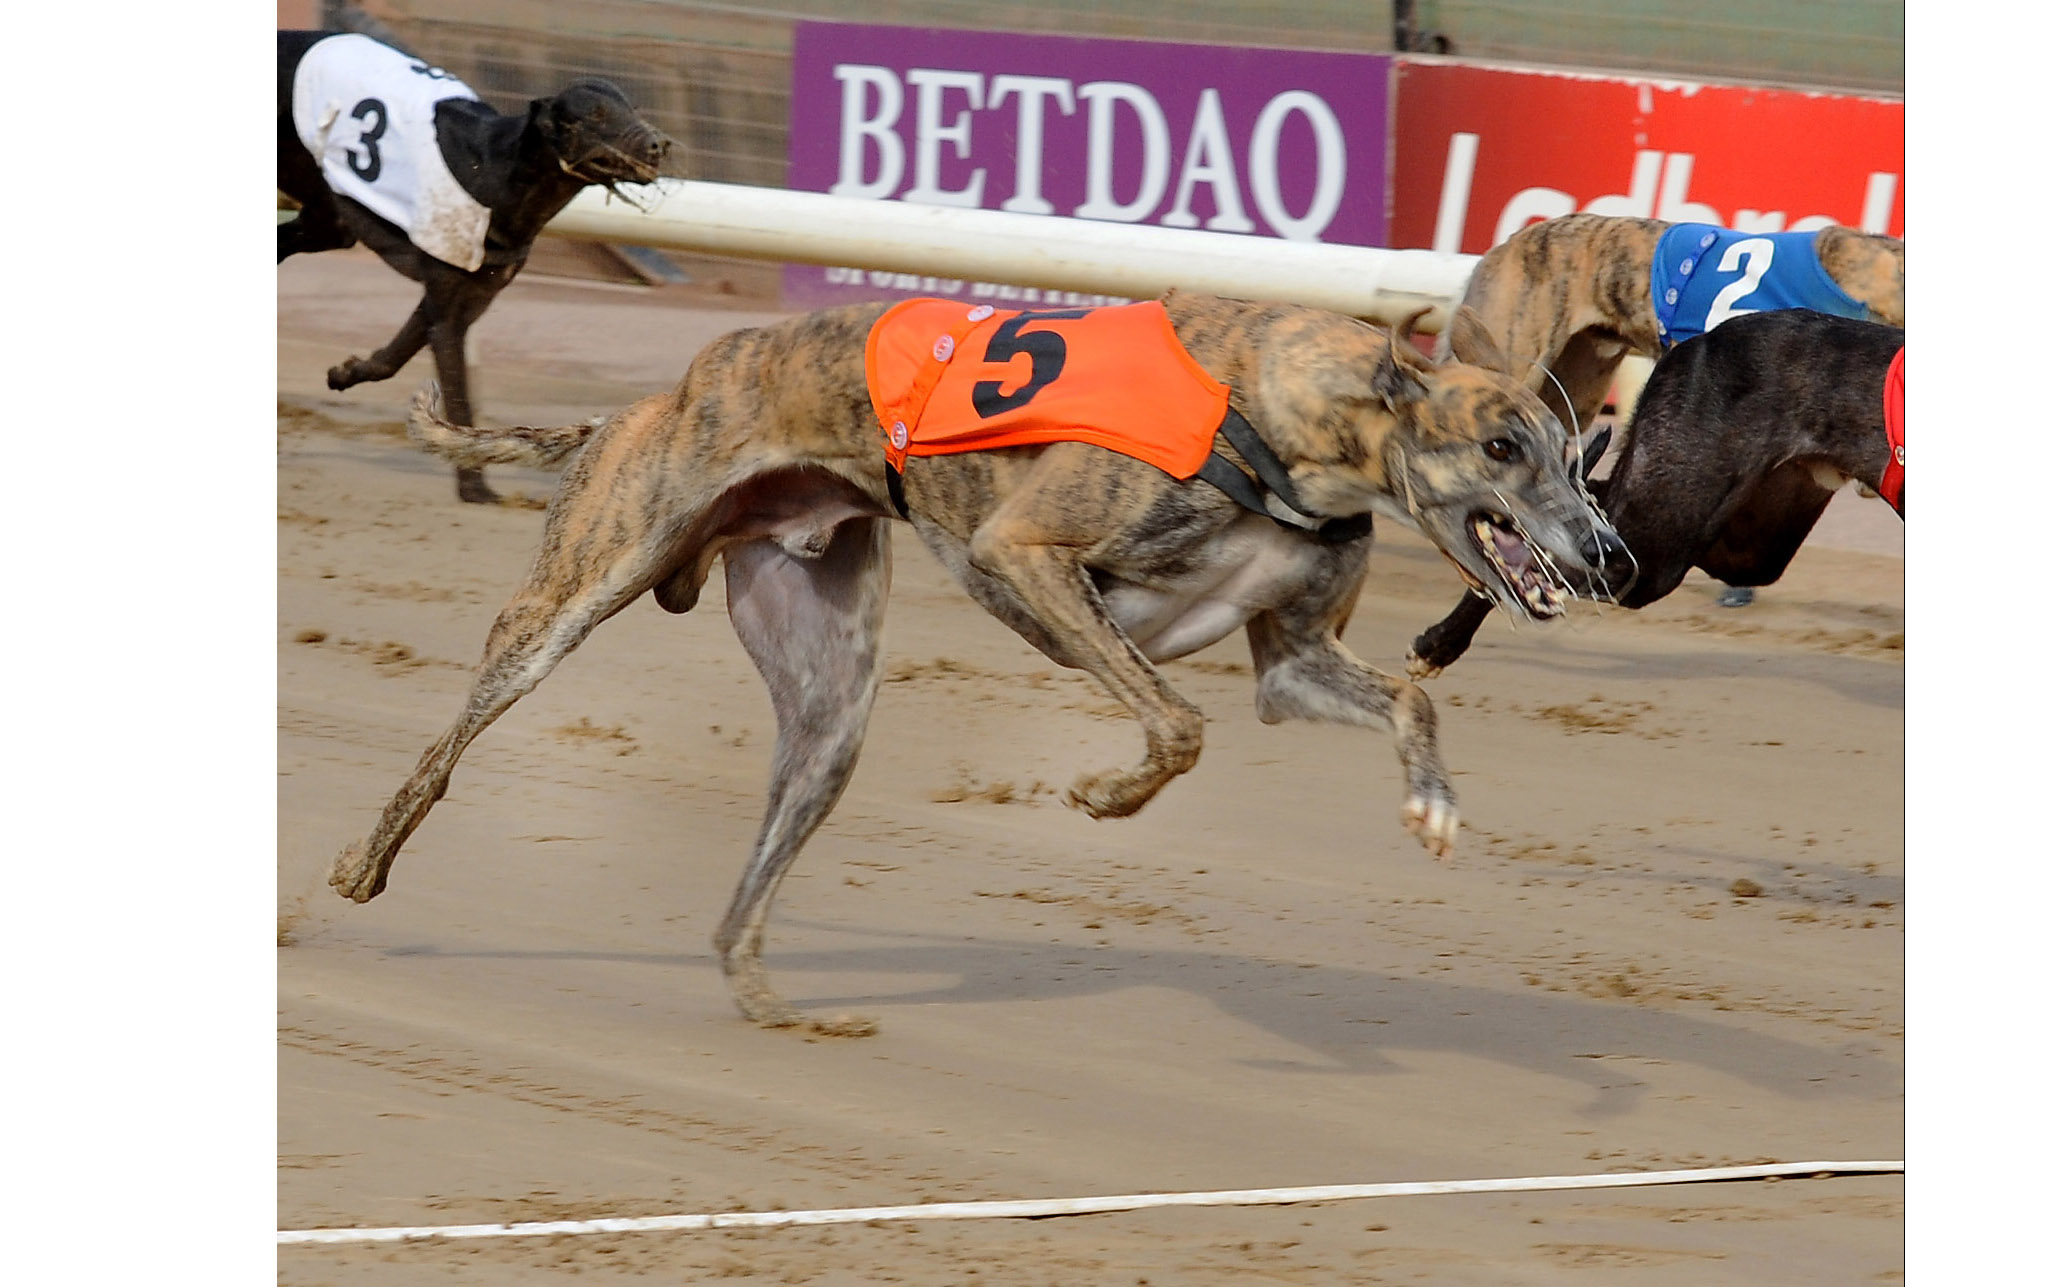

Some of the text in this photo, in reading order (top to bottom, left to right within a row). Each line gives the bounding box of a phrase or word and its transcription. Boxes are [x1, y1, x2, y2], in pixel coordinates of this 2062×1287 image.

[347, 98, 387, 183] 3
[829, 63, 1347, 242] BETDAQ
[1704, 238, 1775, 333] 2
[971, 308, 1093, 419] 5
